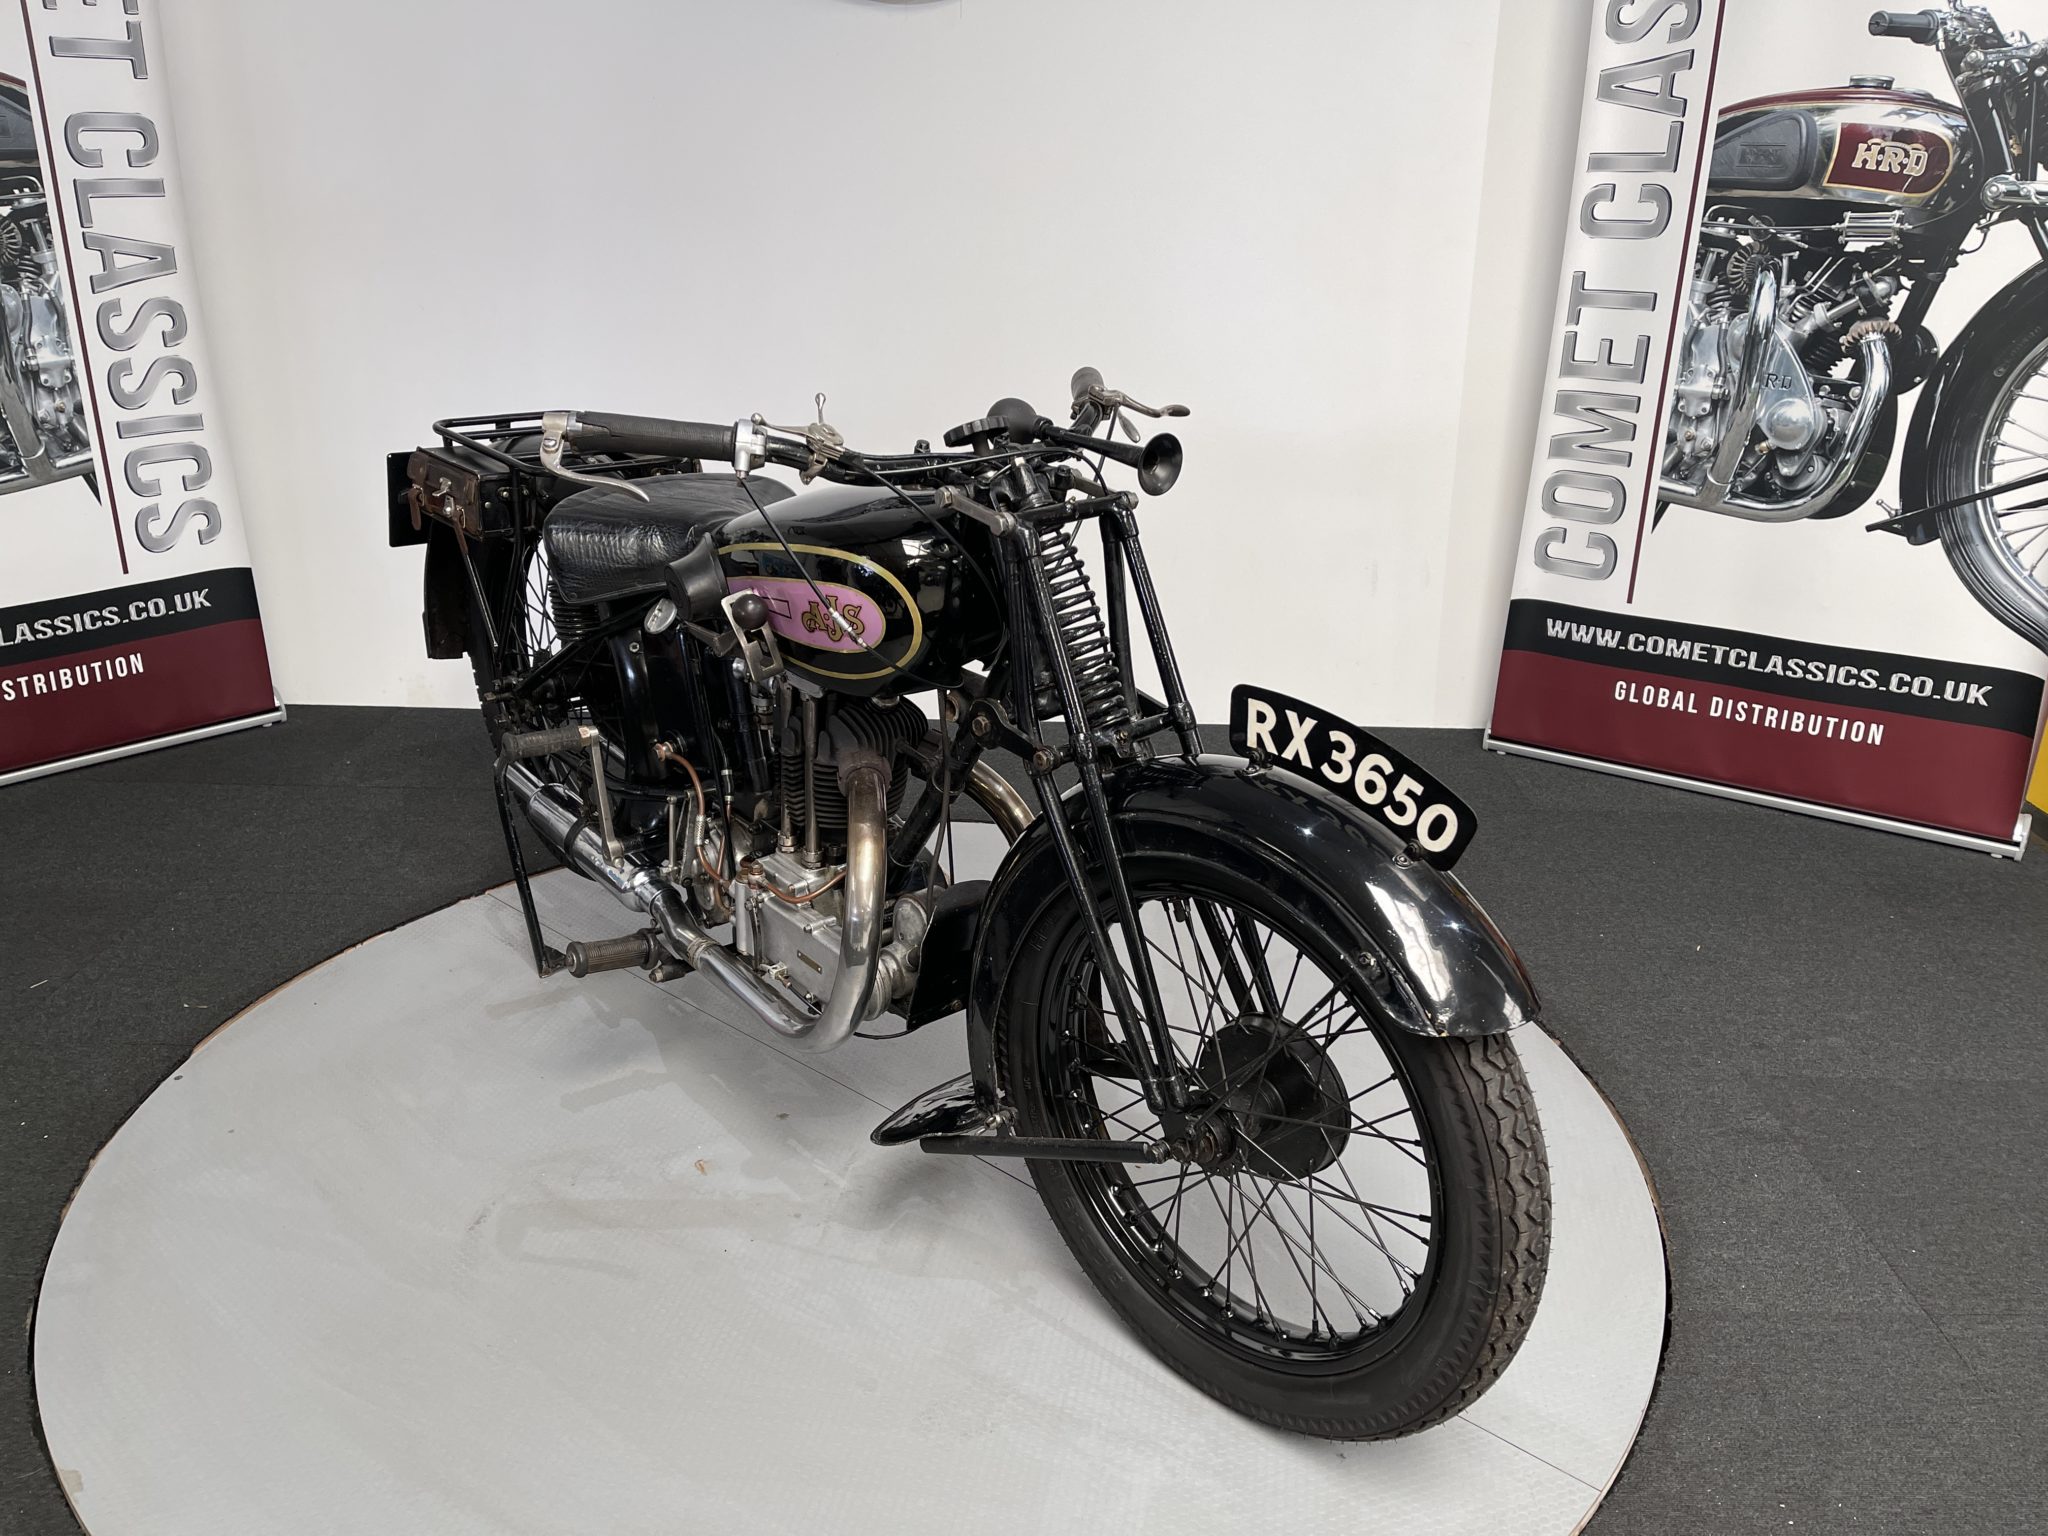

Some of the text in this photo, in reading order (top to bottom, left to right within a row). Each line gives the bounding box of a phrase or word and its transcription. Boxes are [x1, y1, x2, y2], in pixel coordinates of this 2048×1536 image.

[64, 111, 222, 554] CLASSICS
[1534, 271, 1657, 581] COMET
[1, 652, 145, 701] STRIBUTION
[1546, 617, 1993, 708] WWW.COMETCLASSICS.CO.UK
[1614, 680, 1885, 746] GLOBAL DISTRIBUTION
